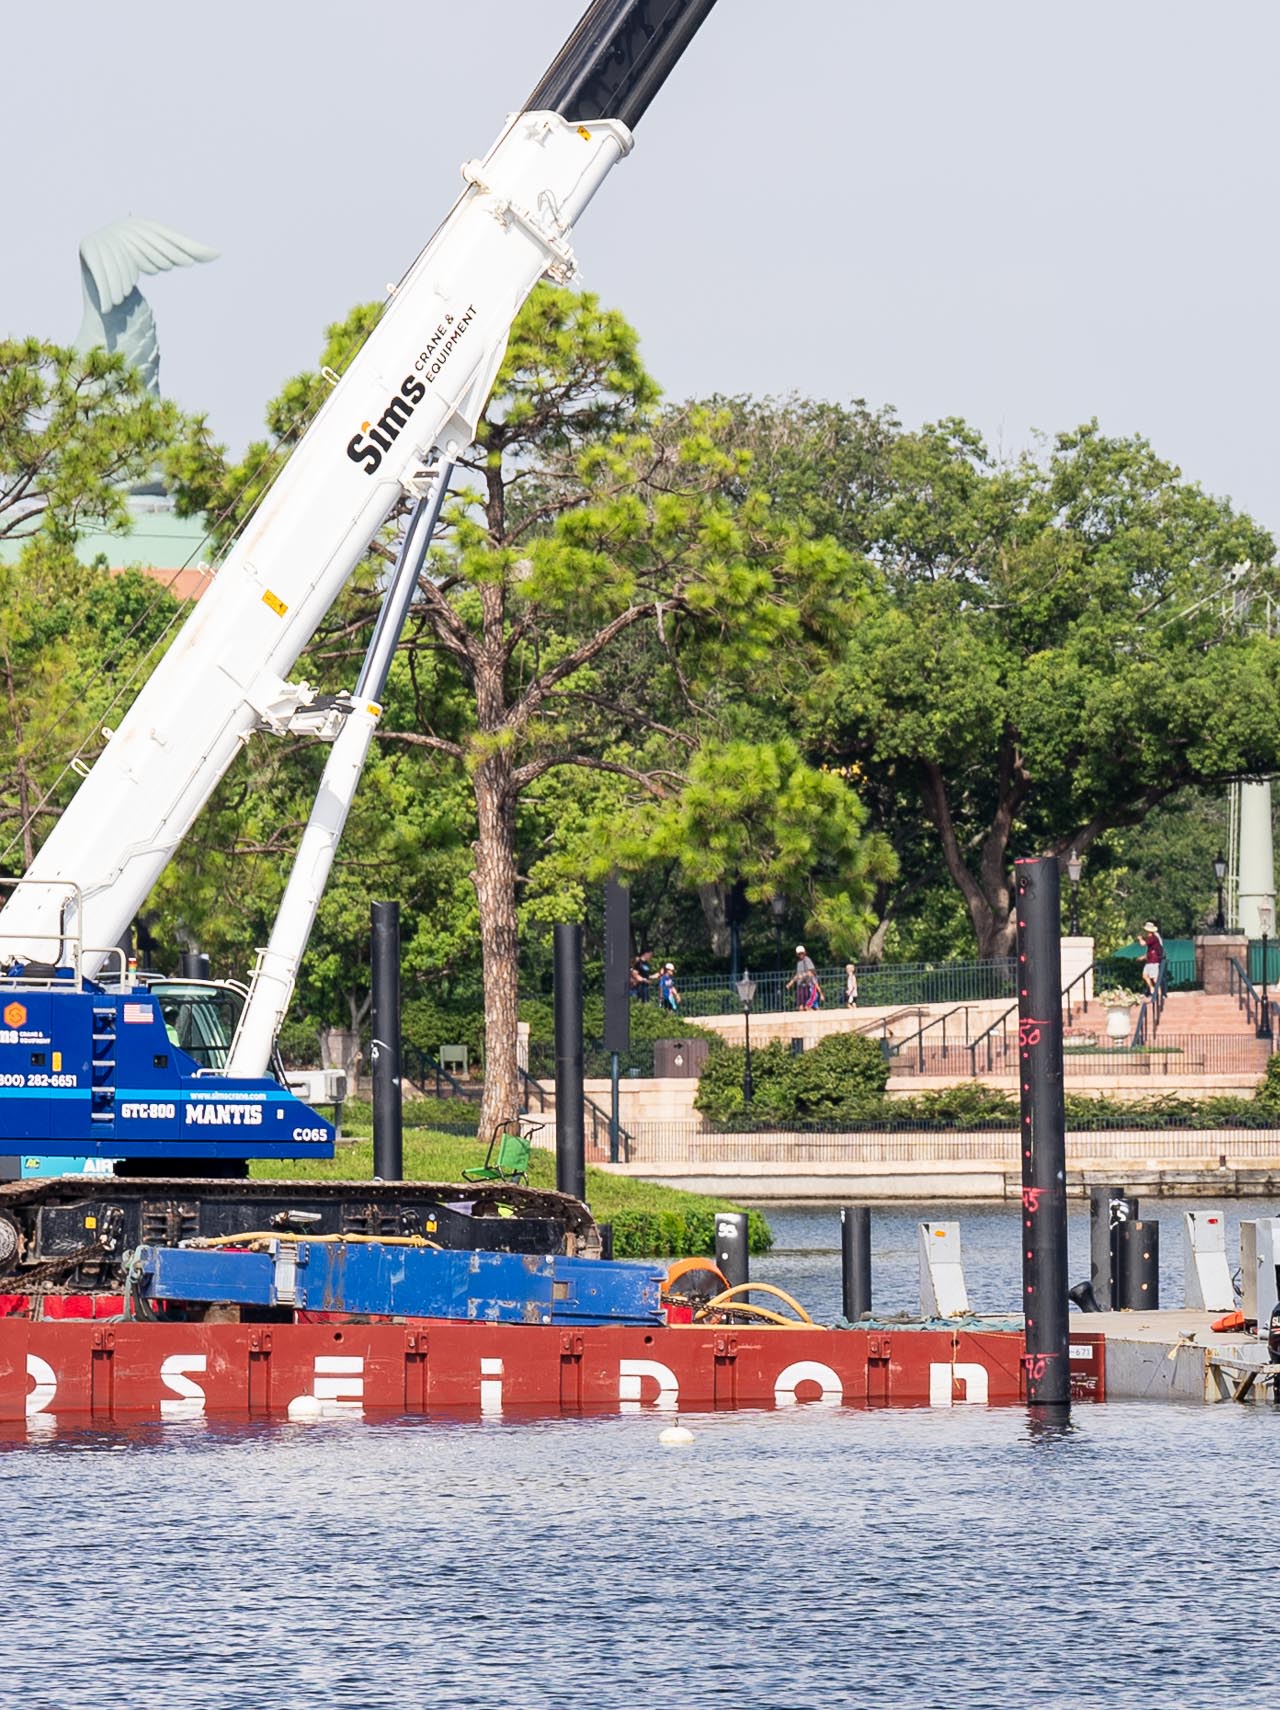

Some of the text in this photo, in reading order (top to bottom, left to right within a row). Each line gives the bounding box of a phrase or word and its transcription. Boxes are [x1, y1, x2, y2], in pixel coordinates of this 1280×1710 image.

[415, 314, 454, 371] CRANE &
[425, 304, 477, 383] EQUIPMENT
[347, 374, 426, 475] Sims
[27, 1074, 77, 1087] 282-6651
[121, 1103, 262, 1125] GTC-800 MANTIS
